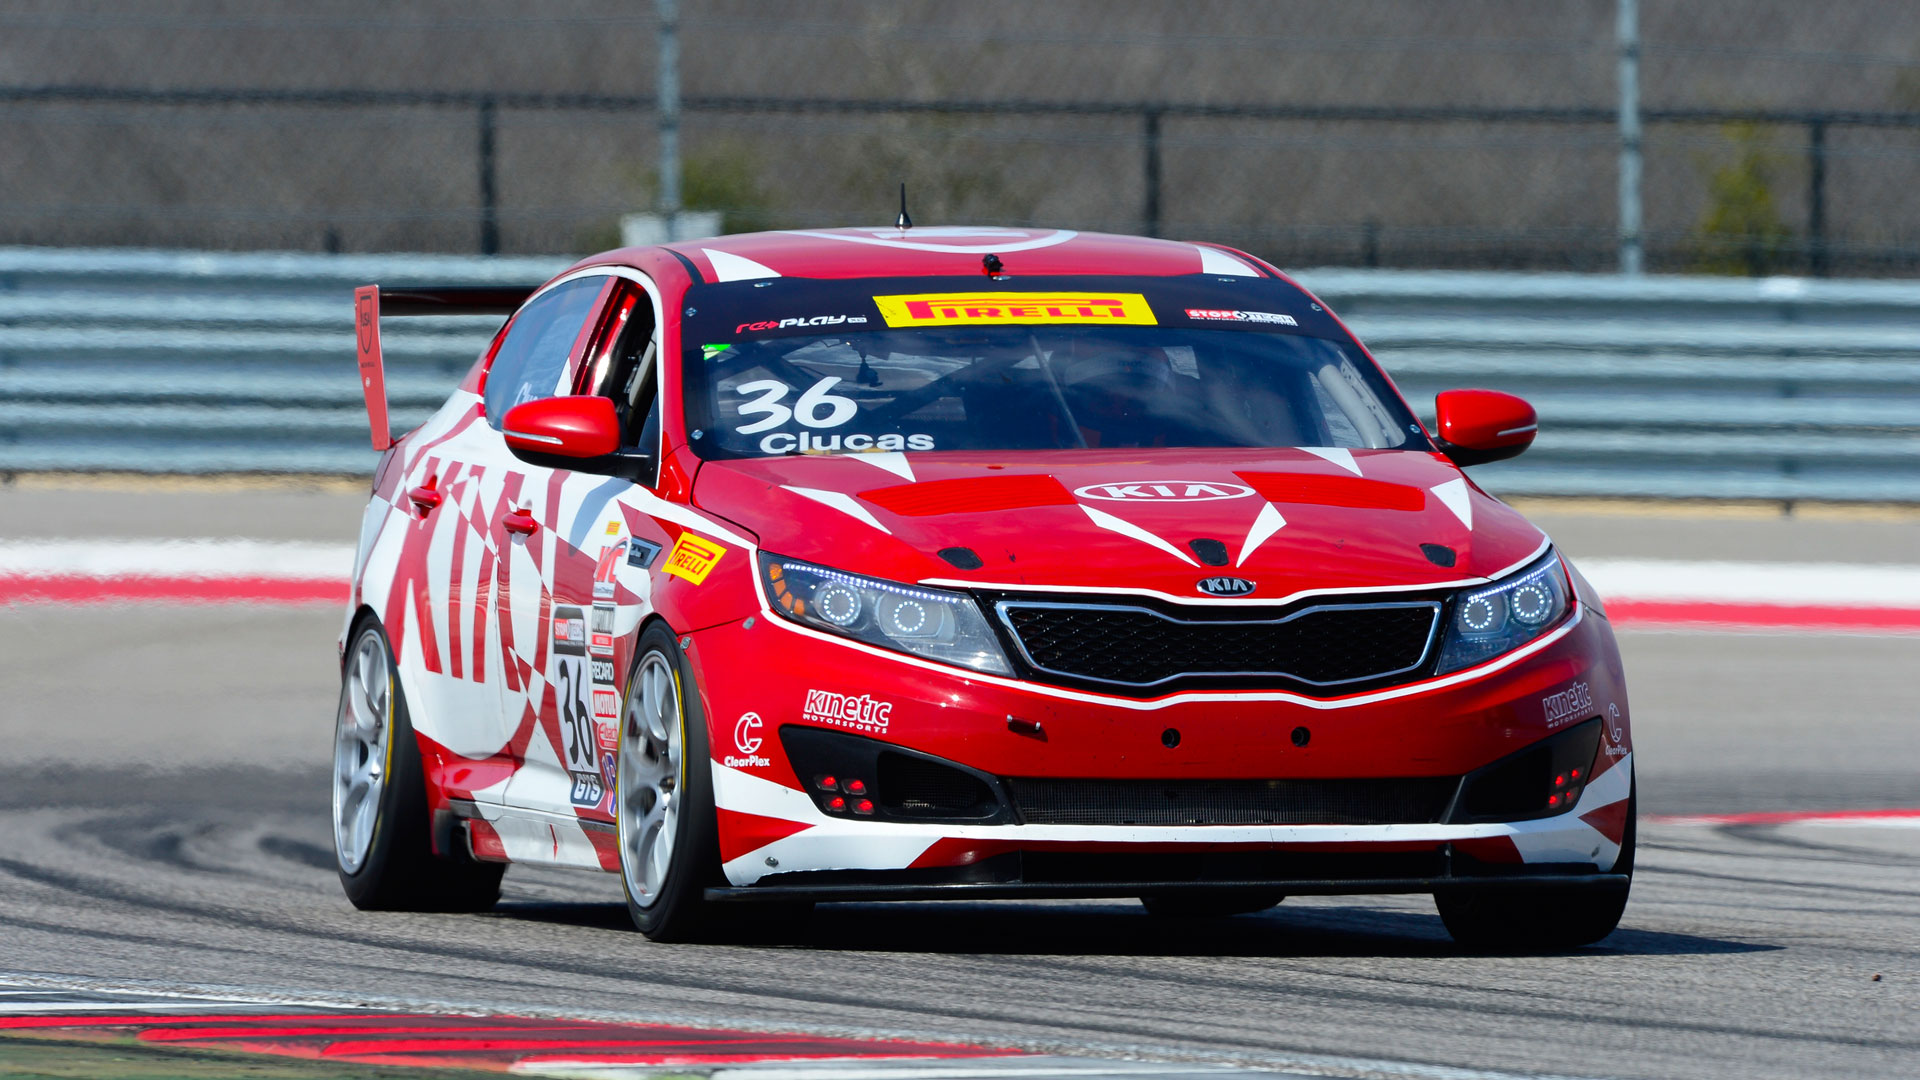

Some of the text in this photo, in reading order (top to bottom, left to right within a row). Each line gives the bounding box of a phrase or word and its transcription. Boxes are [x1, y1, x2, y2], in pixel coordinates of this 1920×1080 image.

[905, 299, 1127, 319] PIRELLI
[736, 376, 857, 434] 36
[760, 431, 935, 454] Clucas
[1101, 484, 1230, 498] KIA
[669, 540, 716, 576] PIRELLI
[1206, 578, 1247, 592] KIA
[559, 658, 593, 768] 36
[594, 692, 617, 715] MOTUL
[803, 714, 888, 734] MOTORSPORTS
[724, 756, 770, 767] ClearPlex
[573, 772, 601, 802] GTS
